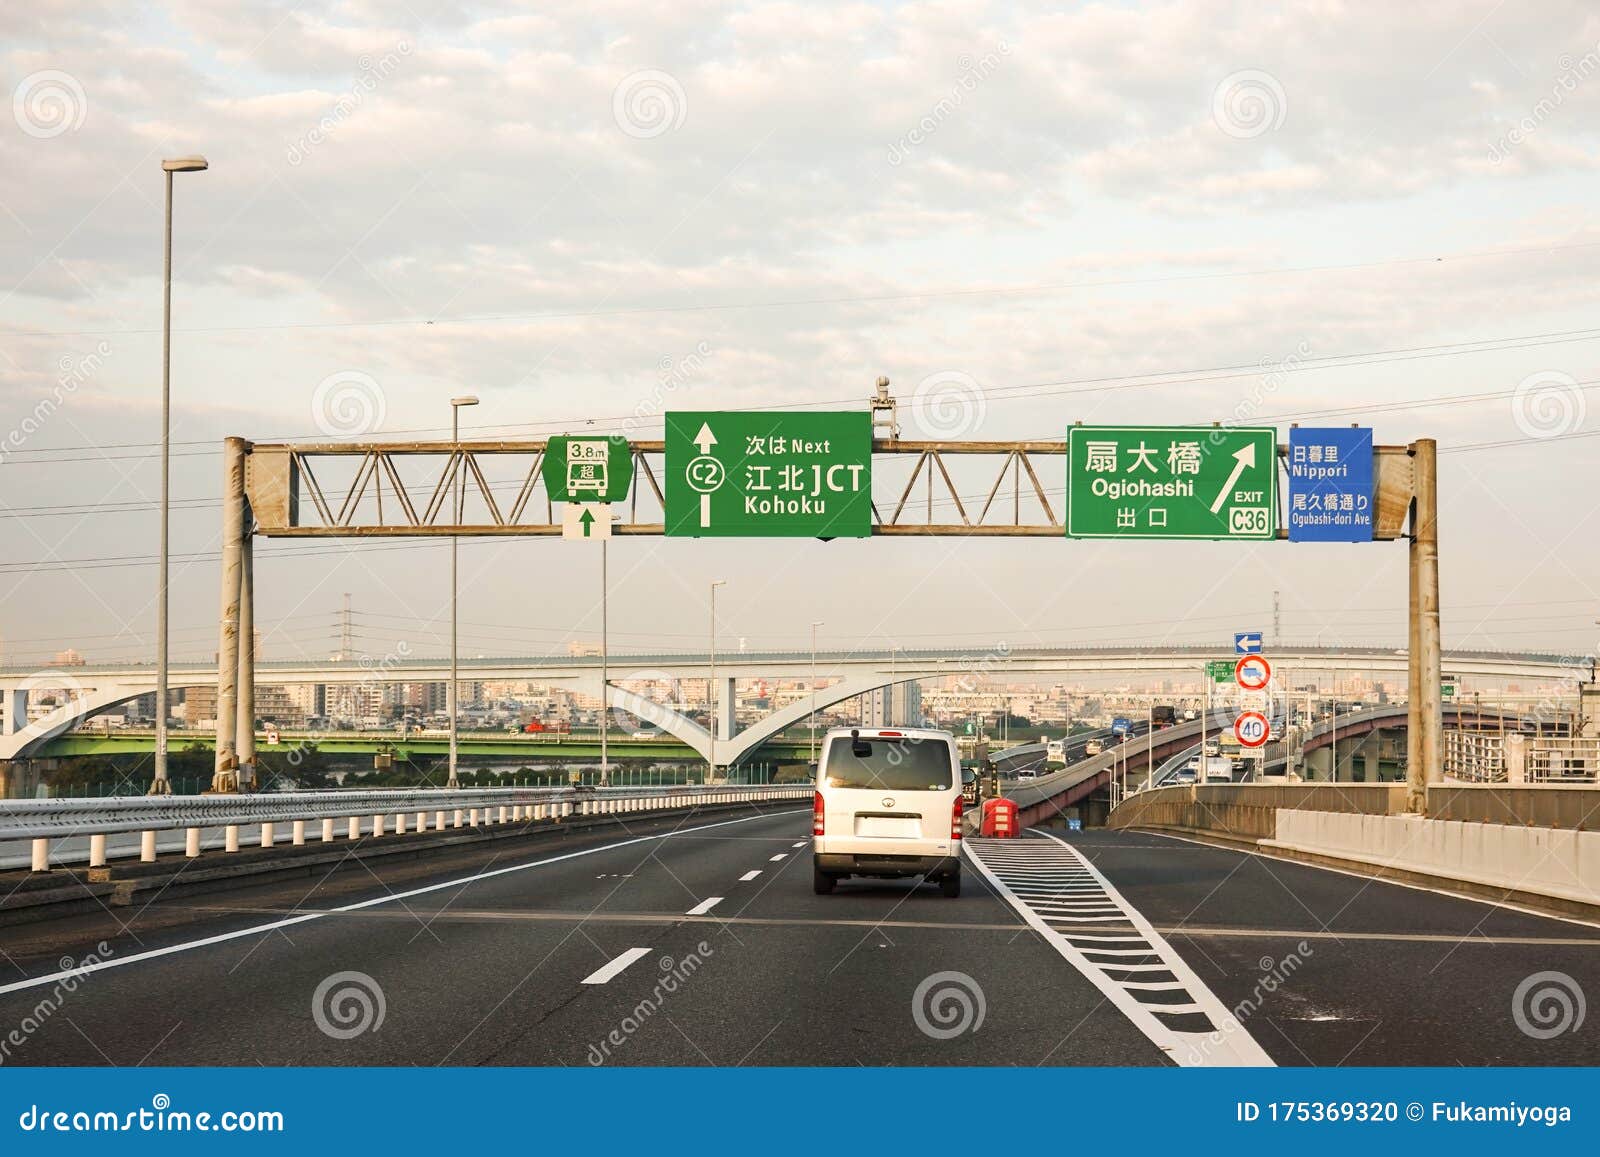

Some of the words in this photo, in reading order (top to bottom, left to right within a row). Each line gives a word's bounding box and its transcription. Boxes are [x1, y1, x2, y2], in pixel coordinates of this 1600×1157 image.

[571, 443, 605, 457] 3.8m
[745, 436, 787, 456] 次は
[791, 439, 831, 454] Next
[1294, 445, 1338, 463] 日暮里
[1085, 440, 1201, 476] 扇大橋
[580, 464, 595, 479] 超
[691, 463, 718, 485] C2
[1292, 464, 1348, 480] Nippori
[1091, 477, 1194, 500] Ogiohashi
[1234, 491, 1263, 503] EXIT
[744, 496, 826, 515] Kohoku
[1293, 494, 1368, 511] 尾久橋通り
[1116, 507, 1168, 528] 出口
[1231, 509, 1267, 531] C36
[1292, 512, 1352, 528] Ogubashi-dori
[1354, 512, 1371, 525] Ave
[1242, 721, 1262, 738] 40
